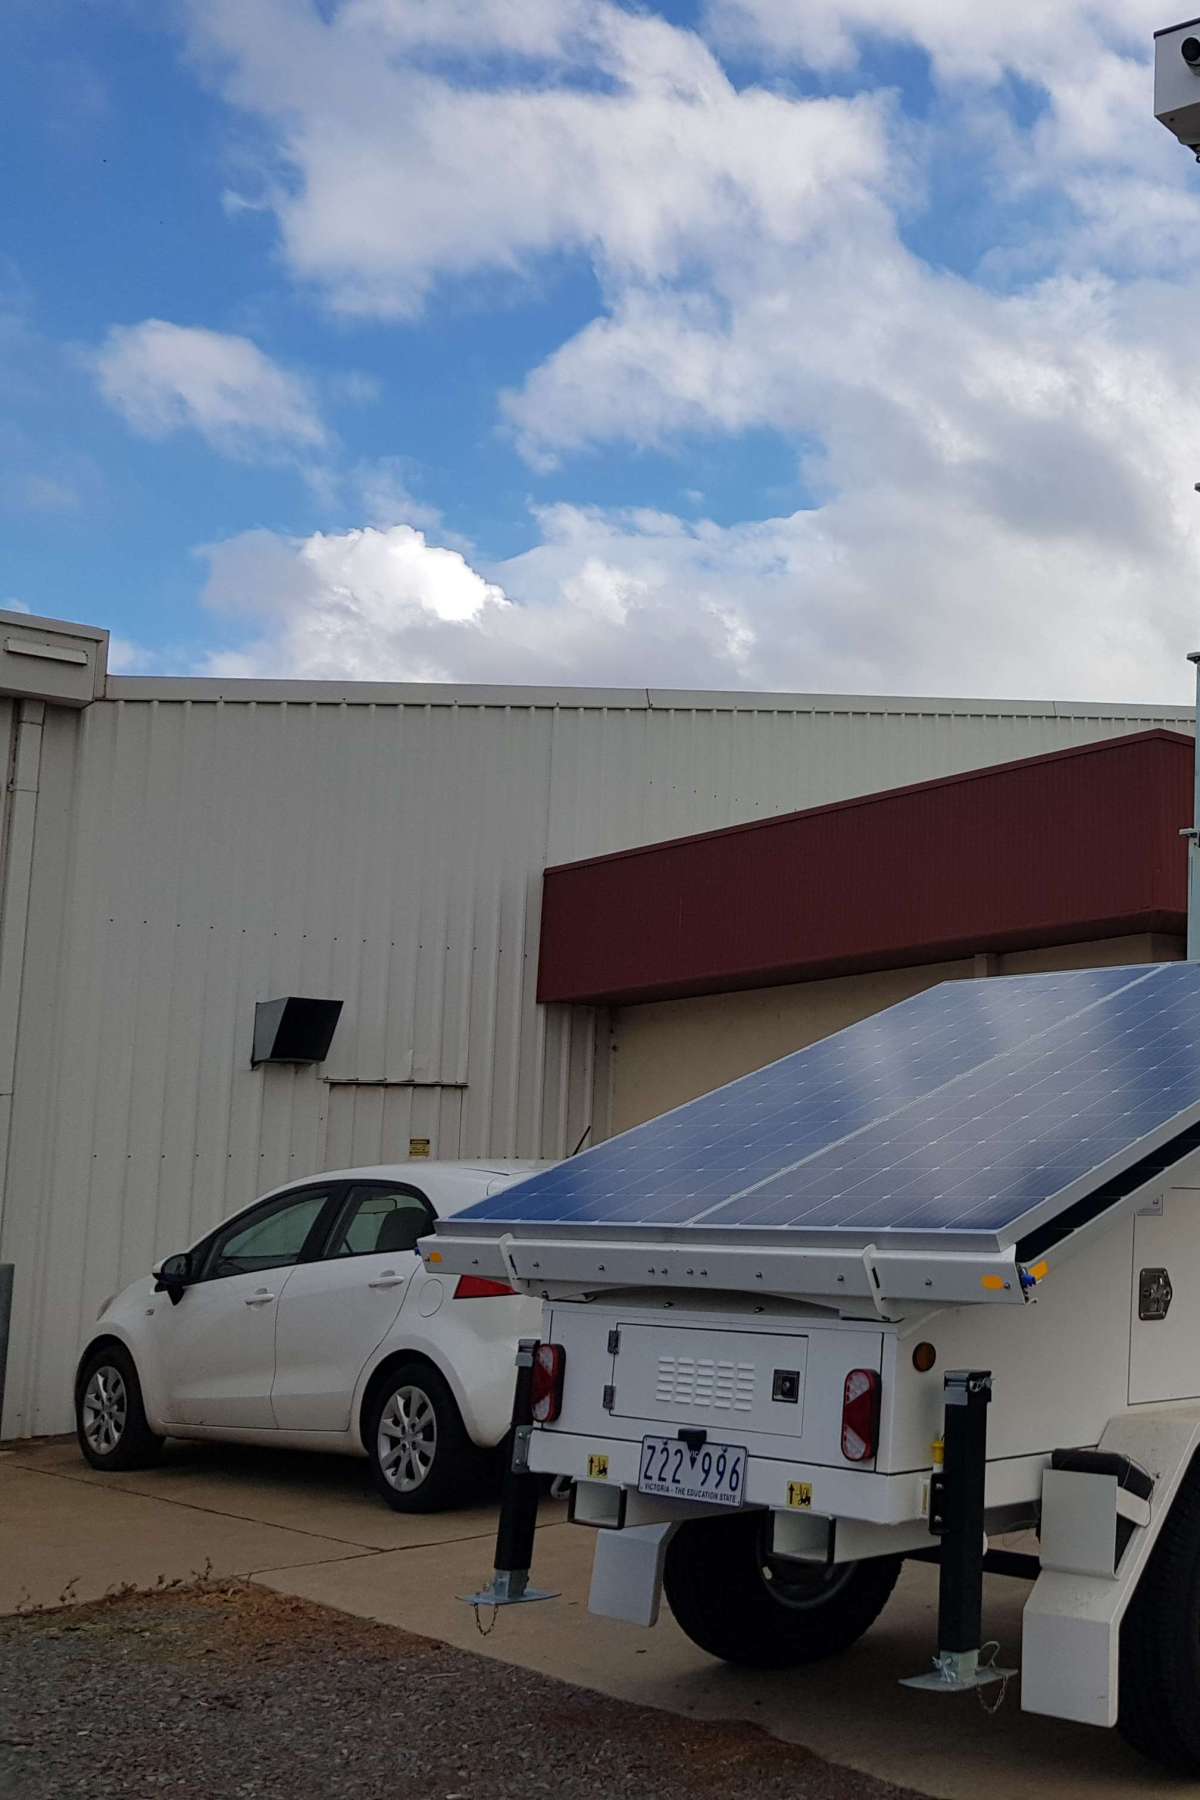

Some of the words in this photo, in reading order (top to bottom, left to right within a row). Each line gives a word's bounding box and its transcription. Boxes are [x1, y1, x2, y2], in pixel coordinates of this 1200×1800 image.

[644, 1445, 684, 1484] Z22
[701, 1452, 741, 1491] 996
[645, 1483, 670, 1493] VICTORIA
[675, 1487, 686, 1496] THE
[687, 1489, 718, 1500] EDUCATION
[720, 1493, 737, 1503] STATE
